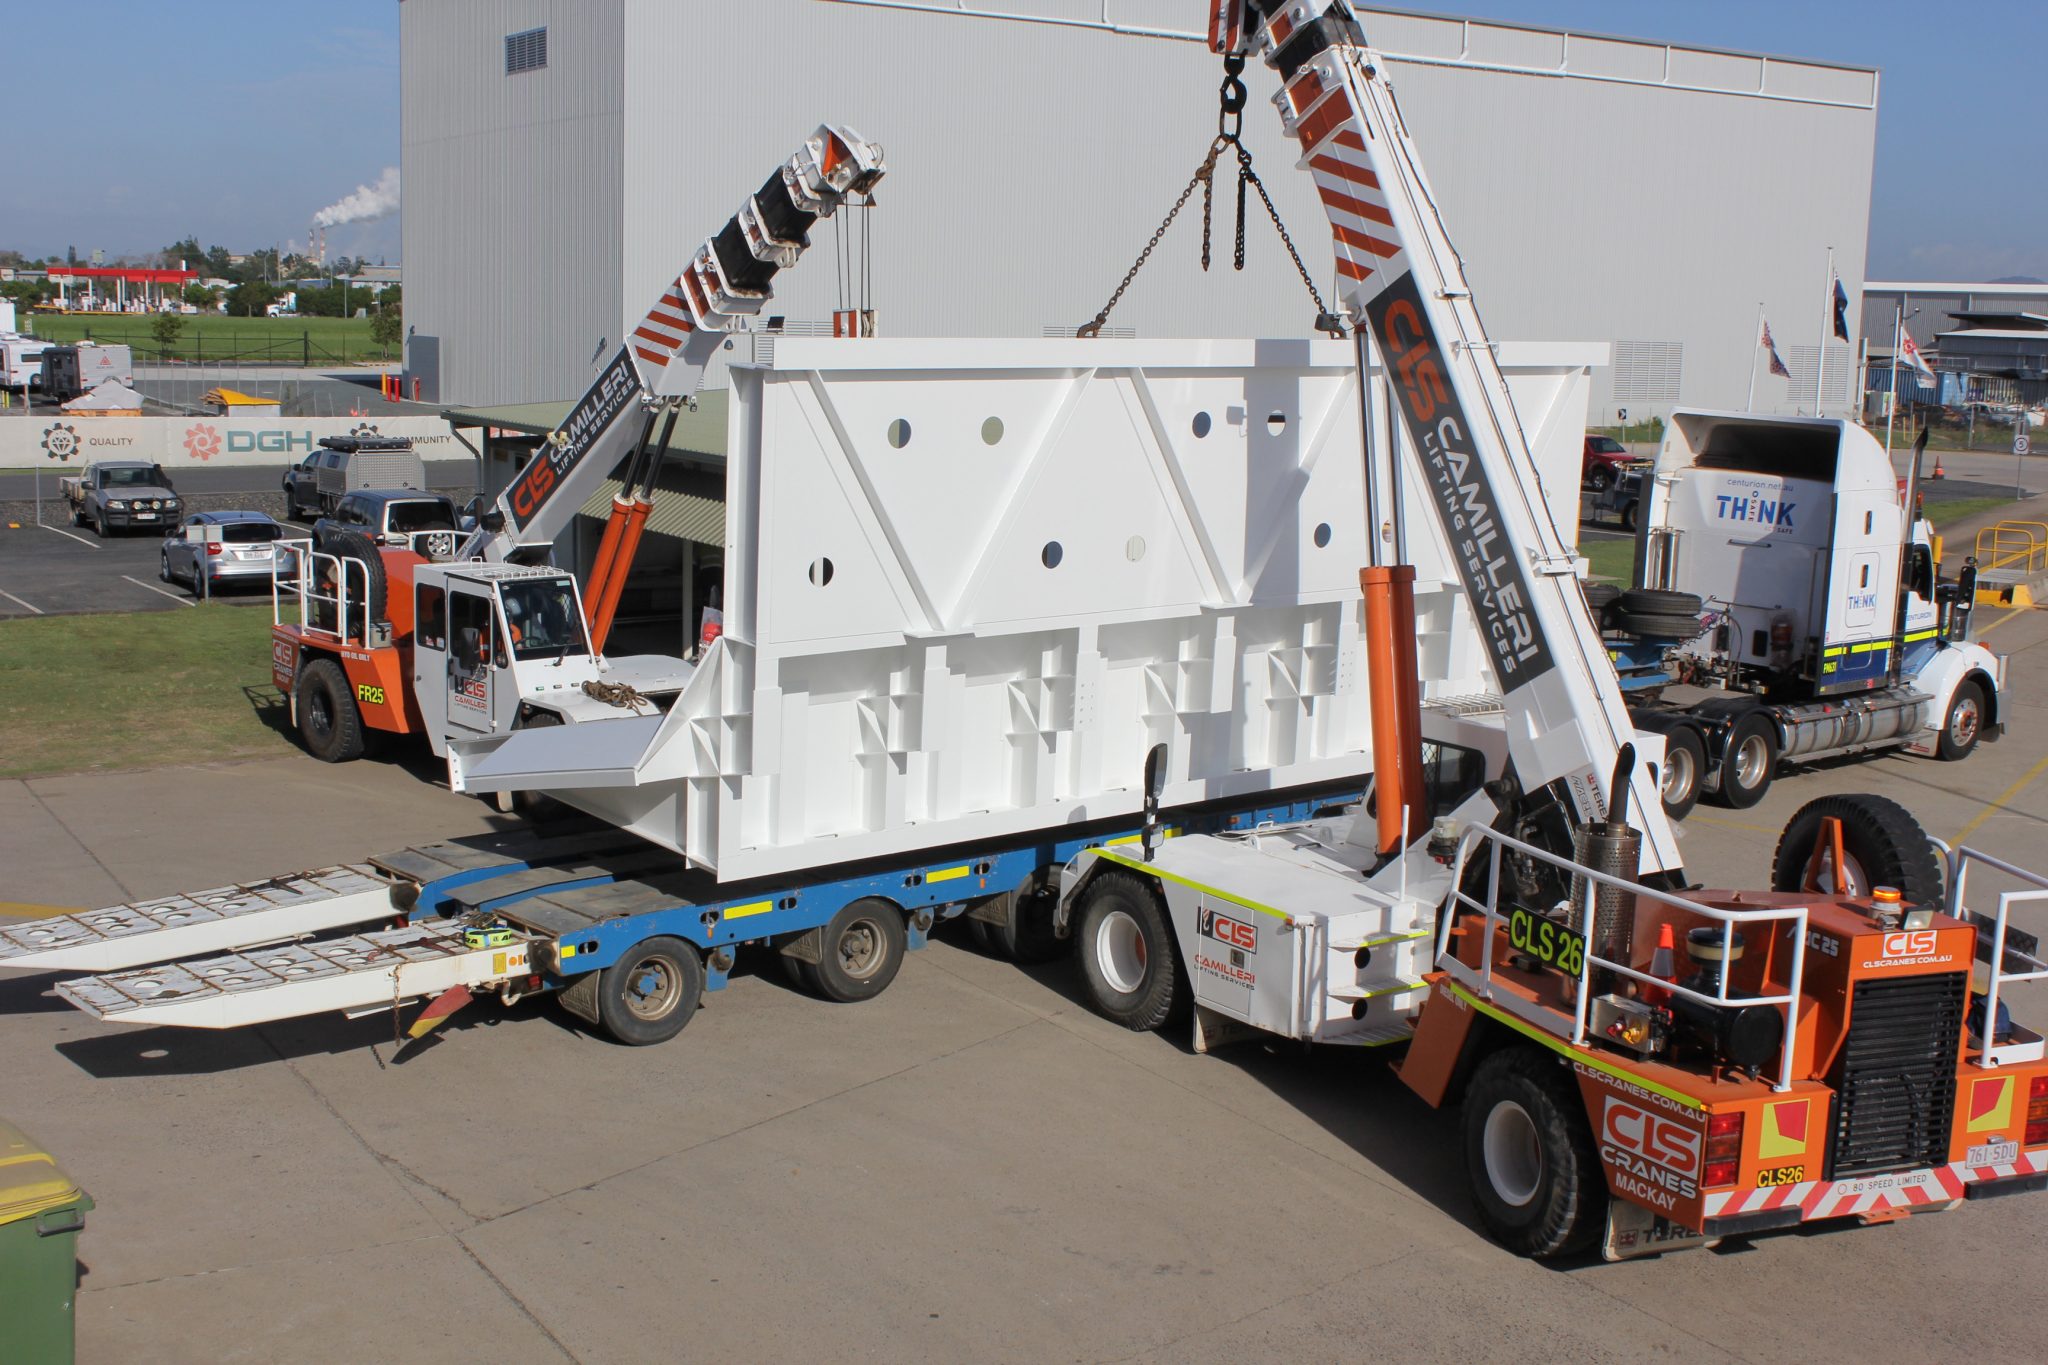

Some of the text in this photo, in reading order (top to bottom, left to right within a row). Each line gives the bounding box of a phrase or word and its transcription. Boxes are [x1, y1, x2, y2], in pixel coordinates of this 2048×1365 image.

[1384, 299, 1449, 424] CLS
[227, 430, 312, 452] DGH
[555, 378, 635, 475] LIFTING SERVICES
[89, 437, 134, 446] QUALITY
[514, 455, 555, 517] CLS
[1727, 479, 1794, 492] centurion.net.au
[1423, 432, 1517, 673] LIFTING SERVICES
[1437, 416, 1540, 663] CAMILLERI
[358, 685, 384, 704] FR25
[464, 681, 486, 698] CLS
[1215, 918, 1255, 948] CLS
[1511, 910, 1583, 976] CLS 26
[1822, 937, 1839, 957] 25
[1885, 932, 1937, 956] CLS
[1194, 954, 1255, 983] CAMILLERI
[1194, 965, 1255, 990] LIFTING SERVICES
[1573, 1061, 1706, 1122] CLSCRANES.COM.AU
[1606, 1104, 1697, 1173] CLS
[1601, 1146, 1697, 1199] CRANES
[1757, 1167, 1804, 1187] CLS26
[1853, 1174, 1927, 1192] 80 SPEED LIMITED
[1616, 1173, 1676, 1211] MACKAY
